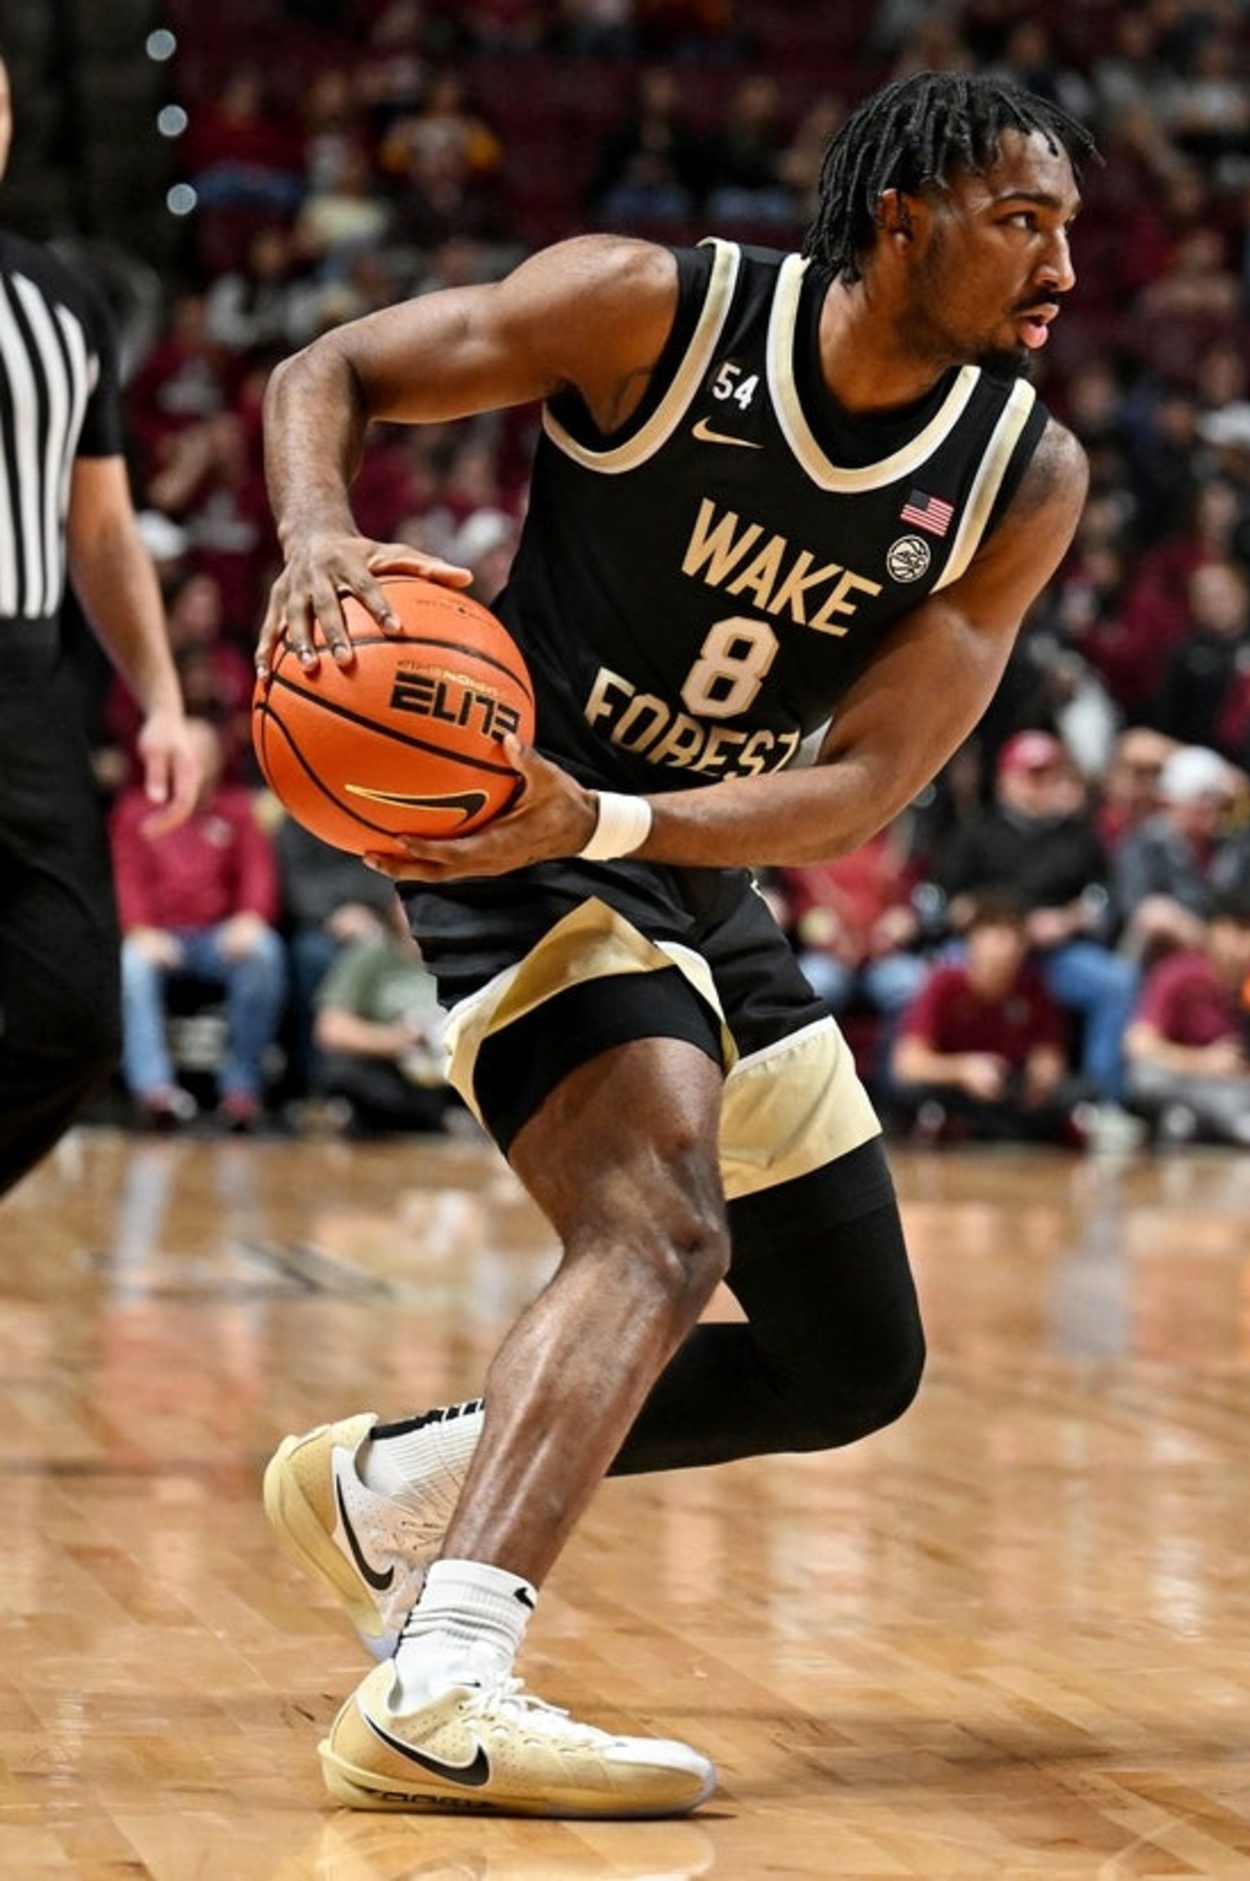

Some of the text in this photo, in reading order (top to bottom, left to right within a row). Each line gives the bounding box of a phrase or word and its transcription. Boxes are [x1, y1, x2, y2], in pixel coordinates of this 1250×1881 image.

[713, 363, 759, 410] 54
[682, 497, 883, 637] WAKE
[390, 671, 520, 744] ELITE
[680, 616, 780, 719] 8
